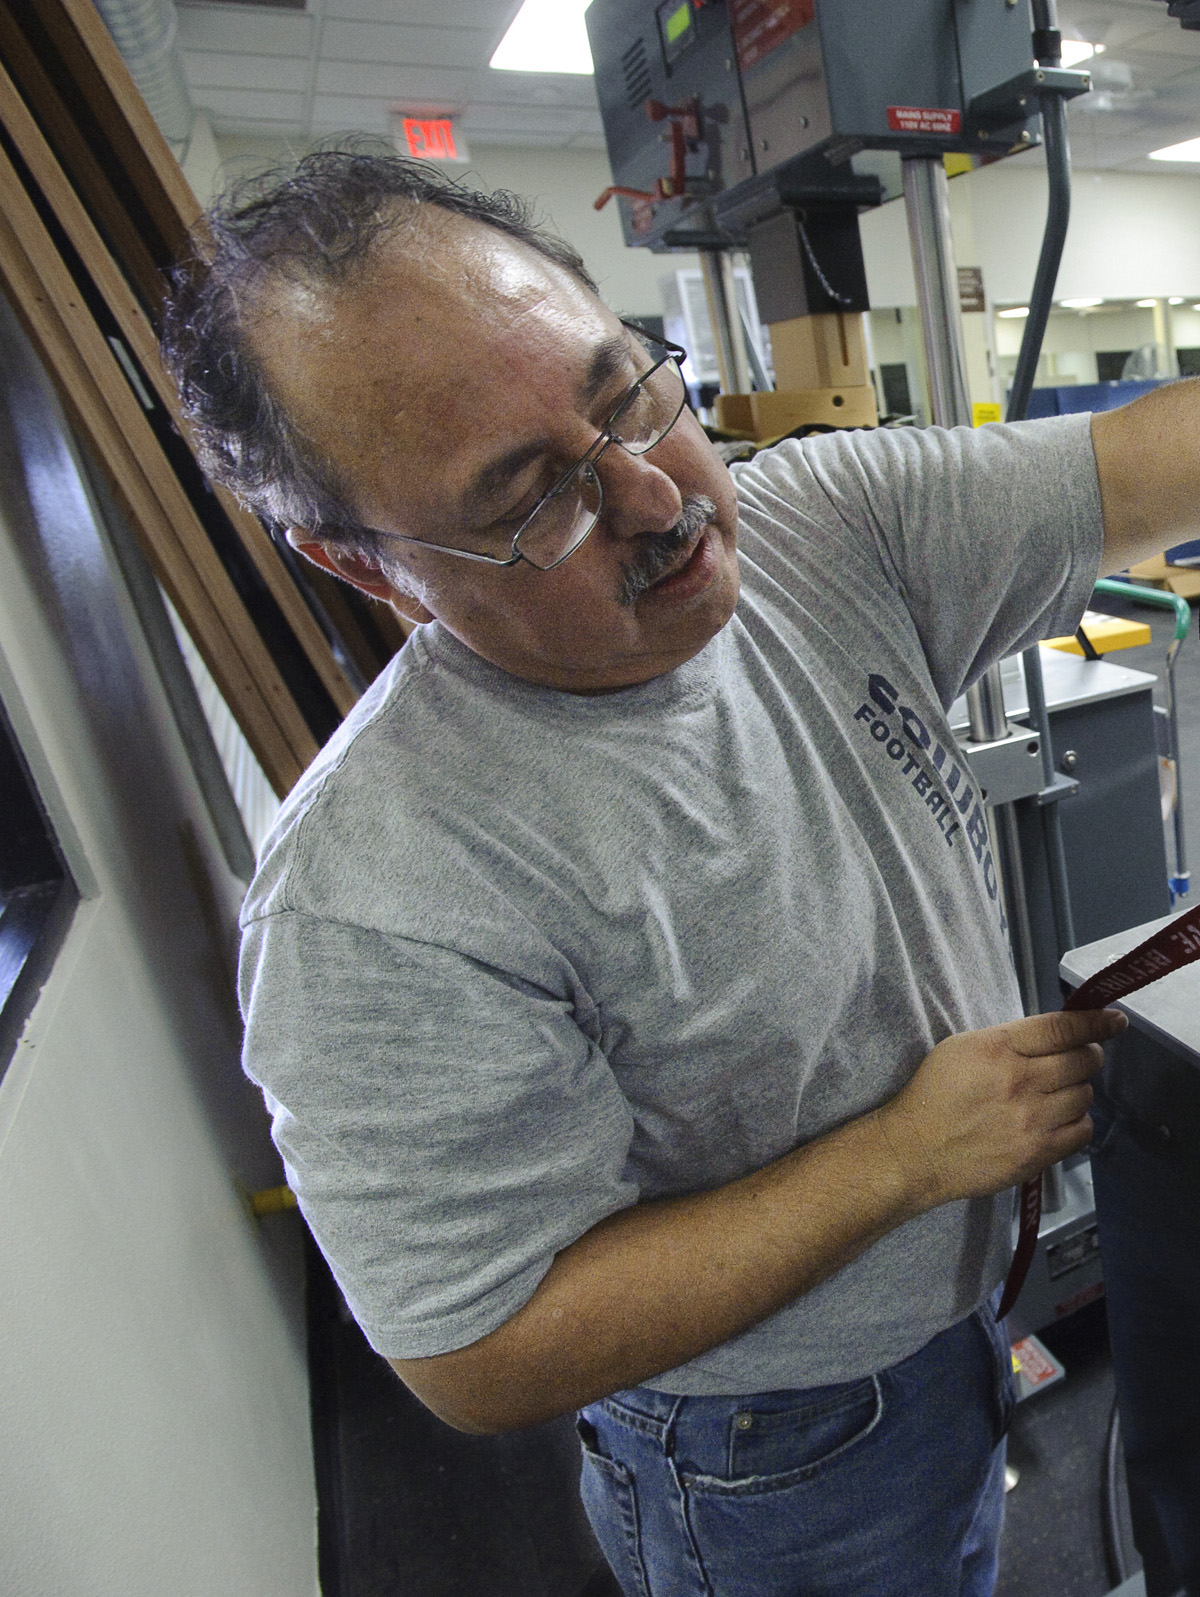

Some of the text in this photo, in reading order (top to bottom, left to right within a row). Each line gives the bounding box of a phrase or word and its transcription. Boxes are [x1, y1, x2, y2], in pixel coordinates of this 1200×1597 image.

[922, 111, 953, 122] SUPPLY
[402, 118, 458, 160] EXIT
[853, 703, 960, 848] FOOTBALL
